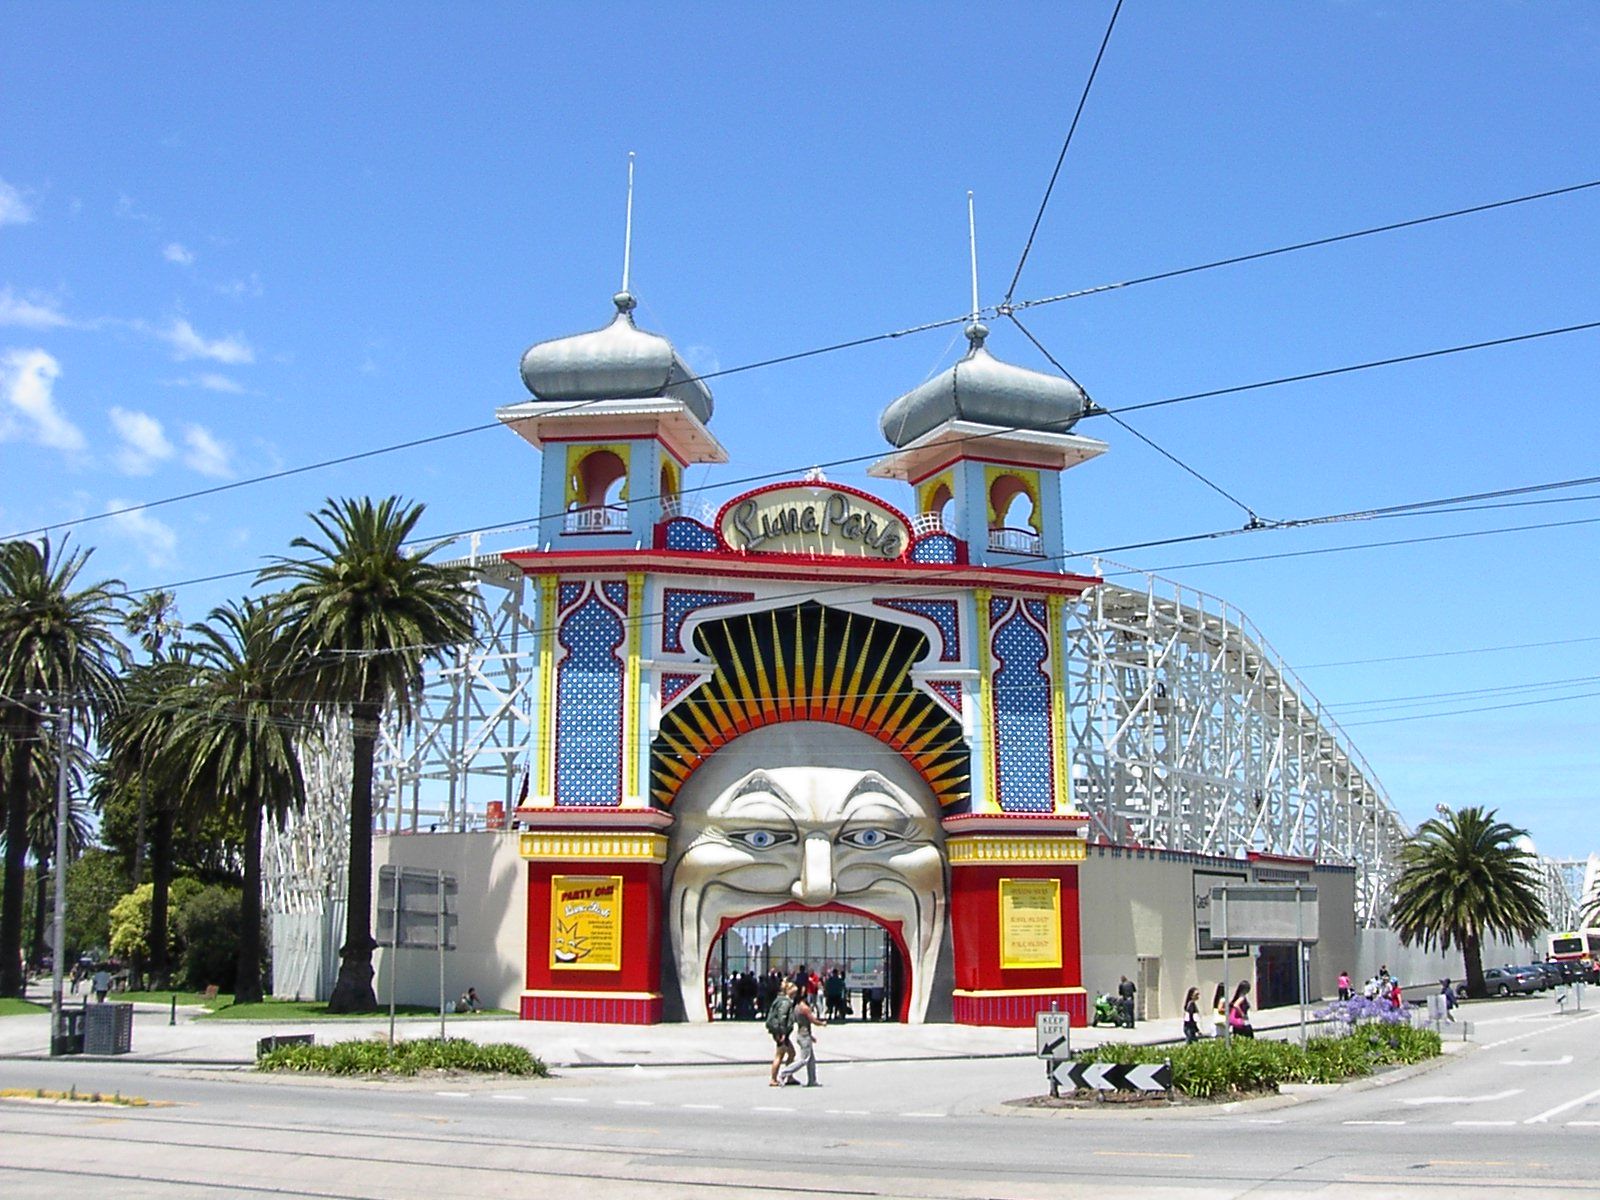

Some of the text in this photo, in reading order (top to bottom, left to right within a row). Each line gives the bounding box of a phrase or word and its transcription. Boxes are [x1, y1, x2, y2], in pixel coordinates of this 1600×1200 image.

[734, 494, 900, 555] Luna Park
[1043, 1026, 1063, 1034] LEFT
